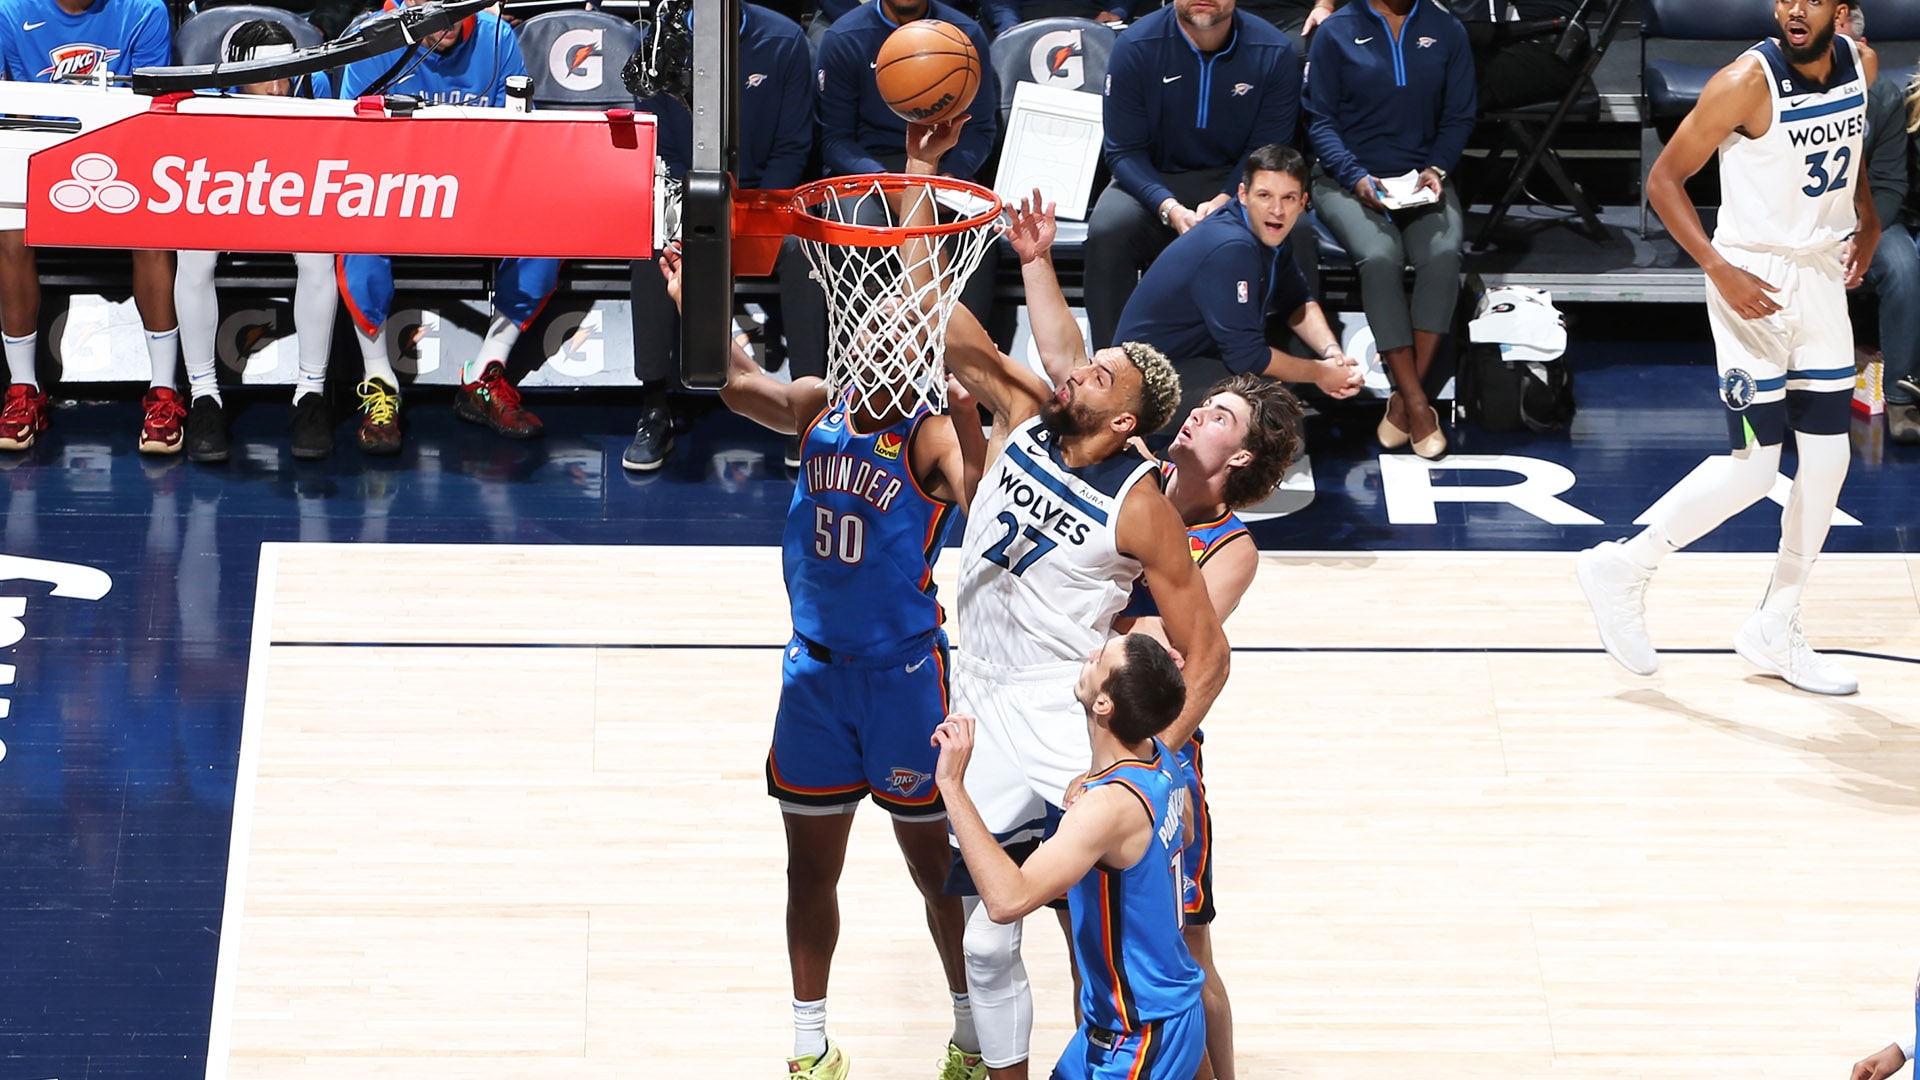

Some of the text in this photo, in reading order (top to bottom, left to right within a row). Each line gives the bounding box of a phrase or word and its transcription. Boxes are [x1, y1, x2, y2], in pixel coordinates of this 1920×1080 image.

[549, 29, 603, 91] G
[1030, 29, 1085, 90] G
[1781, 79, 1793, 92] 6
[1788, 114, 1862, 148] WOLVES
[1802, 146, 1851, 197] 32
[216, 308, 279, 374] G
[543, 309, 604, 377] G
[829, 412, 842, 424] 6
[1036, 429, 1050, 443] 6
[805, 455, 902, 512] THUNDER
[998, 466, 1091, 546] WOLVES
[814, 505, 864, 565] 50
[981, 510, 1058, 577] 27
